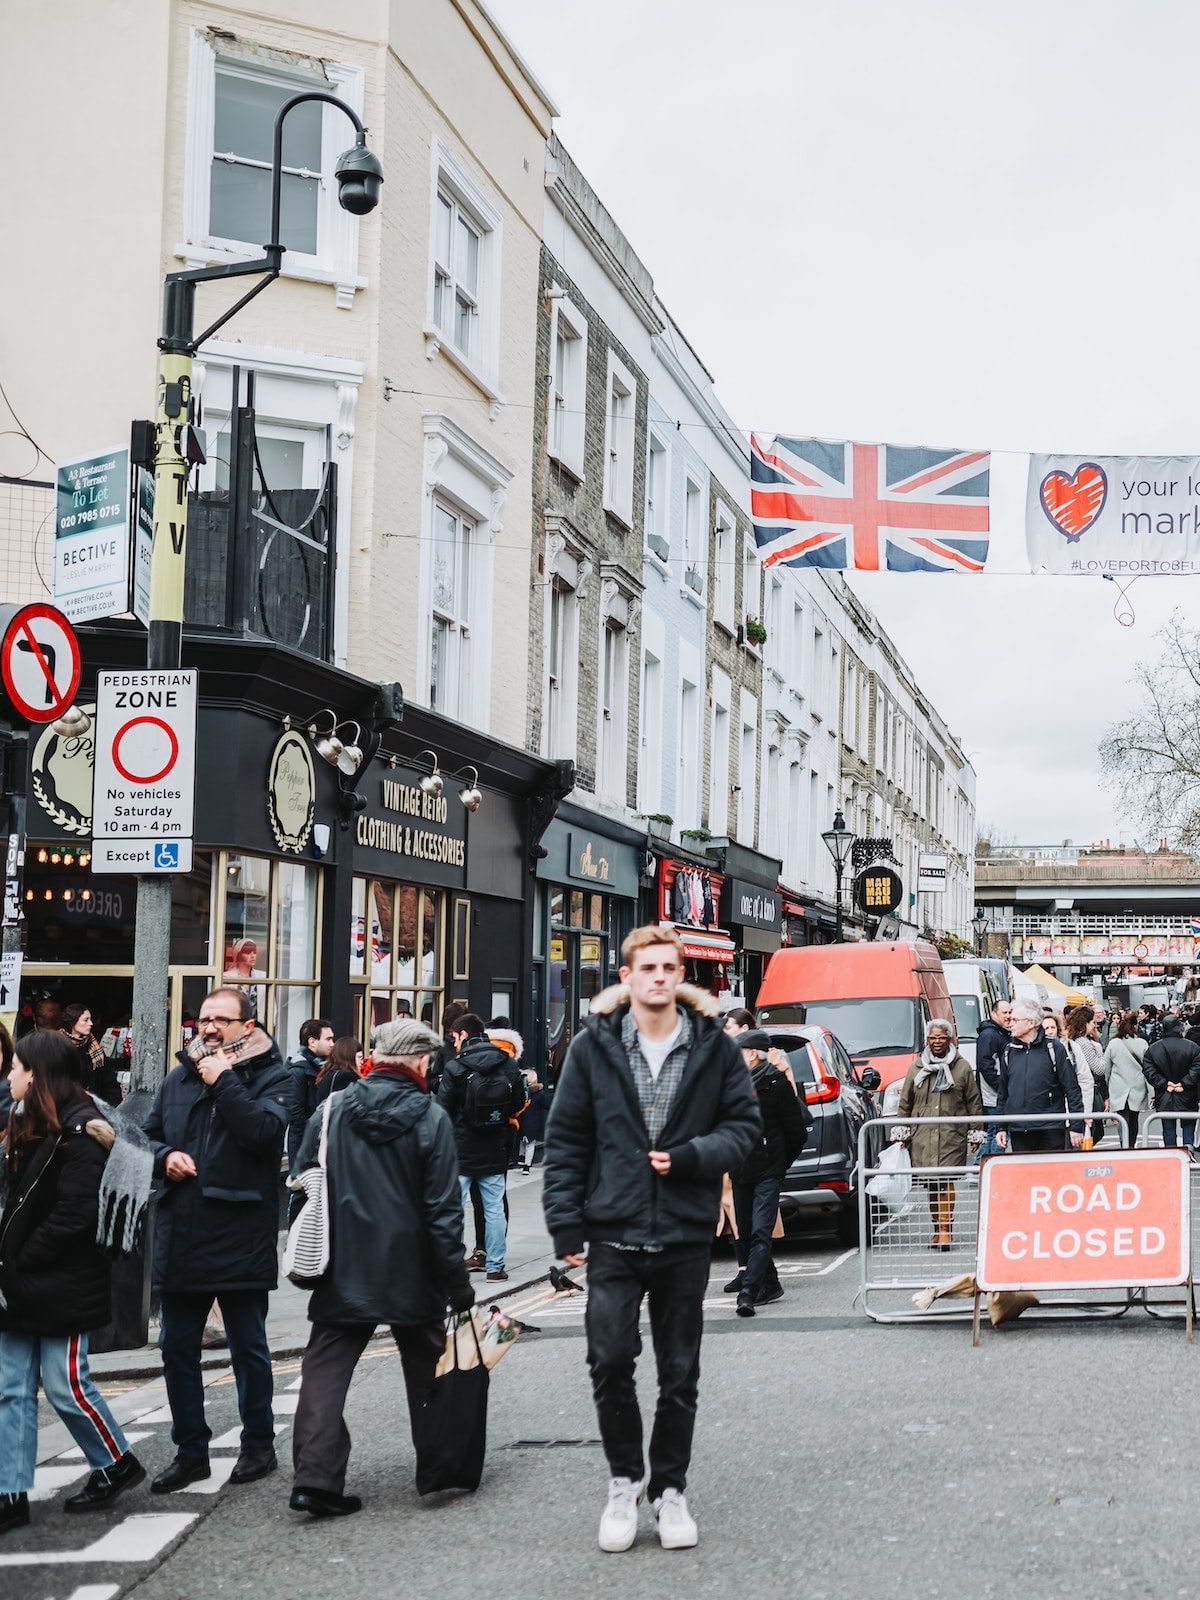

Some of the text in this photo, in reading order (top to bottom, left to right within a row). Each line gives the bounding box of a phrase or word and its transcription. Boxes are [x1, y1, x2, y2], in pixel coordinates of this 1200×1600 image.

[67, 459, 116, 481] A3 Restaurant
[74, 475, 108, 490] & Terrace
[1122, 480, 1179, 500] your
[72, 485, 109, 508] To Let
[60, 503, 120, 529] 020 7985 0715
[63, 540, 117, 567] BECTIVE
[103, 675, 191, 687] PEDESTRIAN
[115, 691, 178, 709] ZONE
[107, 788, 181, 800] No vehicles
[383, 779, 448, 825] VINTAGE RETRO
[114, 806, 173, 818] Saturday
[104, 822, 118, 832] 10
[122, 824, 140, 832] am
[151, 821, 158, 832] 4
[163, 824, 181, 833] pm
[357, 815, 465, 867] CLOTHING & ACCESSORIES
[106, 850, 150, 863] Except
[920, 868, 945, 877] FOR SALE
[865, 877, 891, 887] MAU
[865, 887, 891, 897] MAU
[866, 896, 891, 906] BAR
[740, 895, 753, 917] one
[1029, 1183, 1142, 1214] ROAD
[1001, 1226, 1166, 1260] CLOSED
